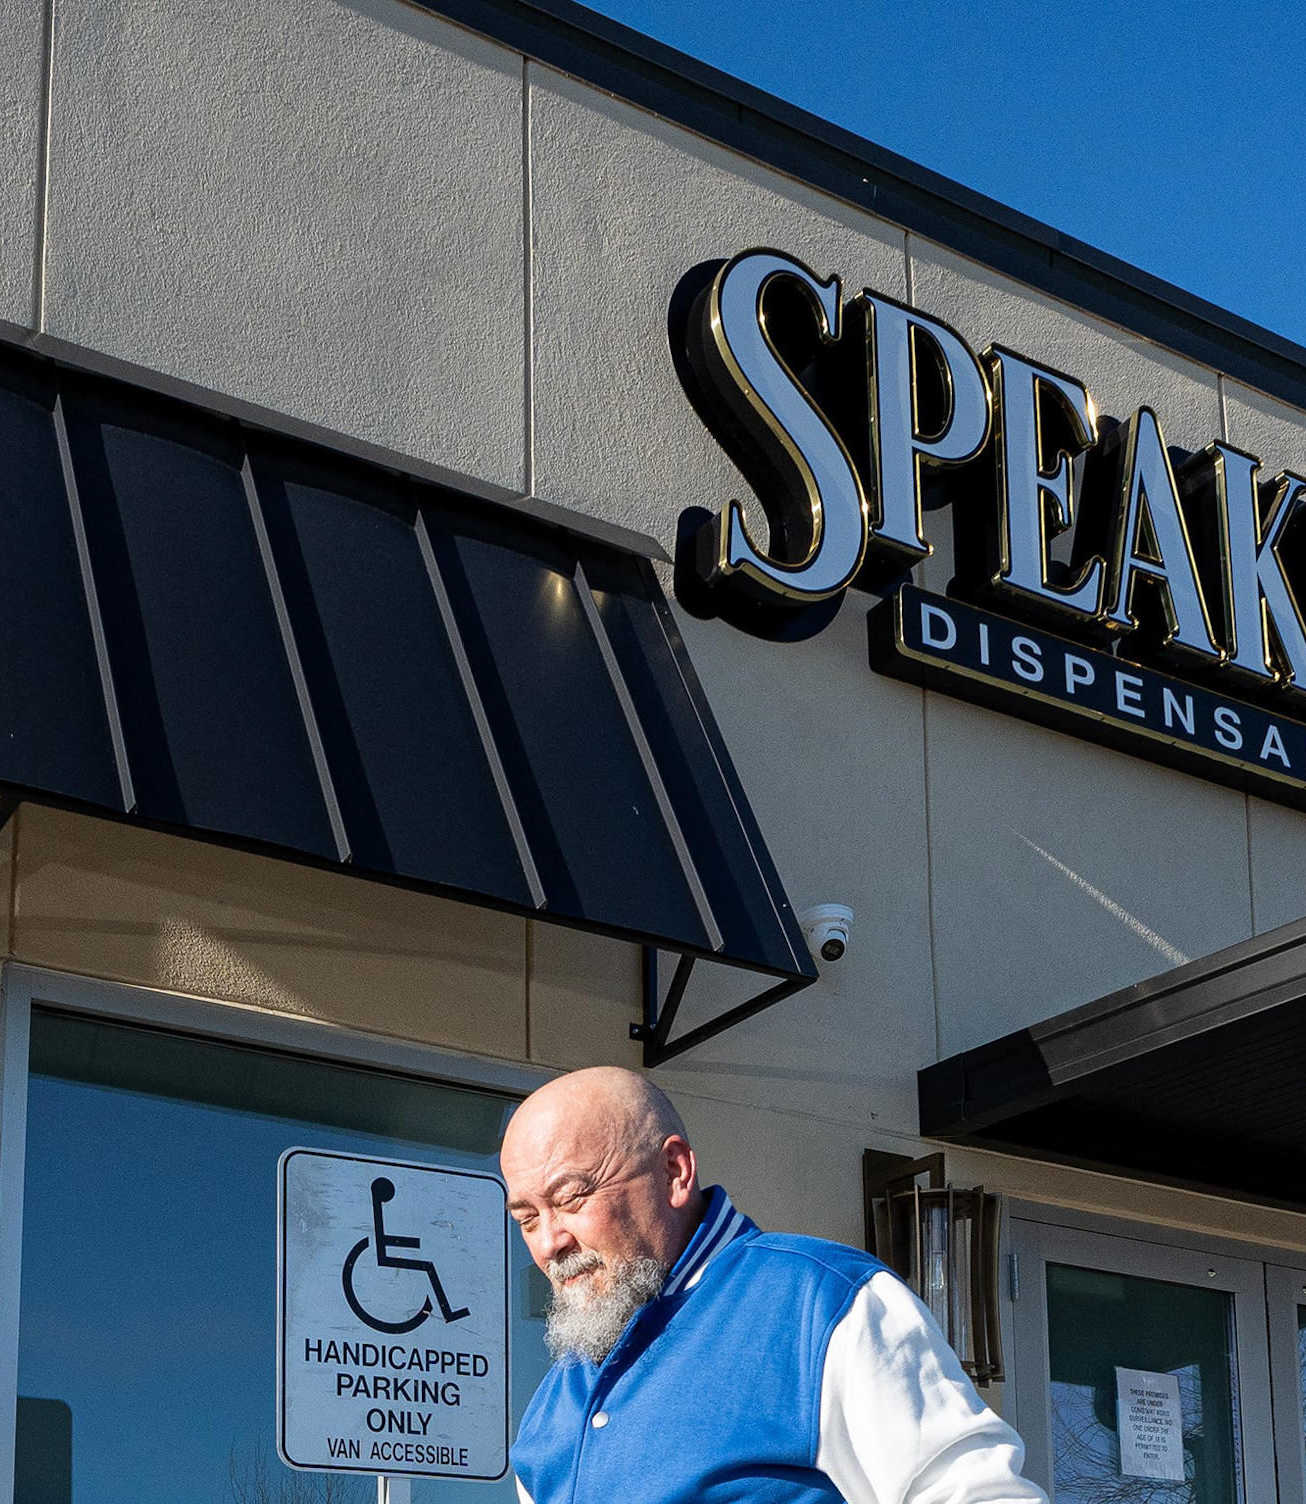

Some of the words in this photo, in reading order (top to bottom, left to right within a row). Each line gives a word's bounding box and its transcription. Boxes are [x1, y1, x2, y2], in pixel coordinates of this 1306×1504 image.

[305, 1338, 489, 1378] HANDICAPPED
[336, 1373, 461, 1406] PARKING
[366, 1407, 433, 1436] ONLY
[327, 1437, 361, 1459] VAN
[370, 1441, 469, 1467] ACCESSIBLE
